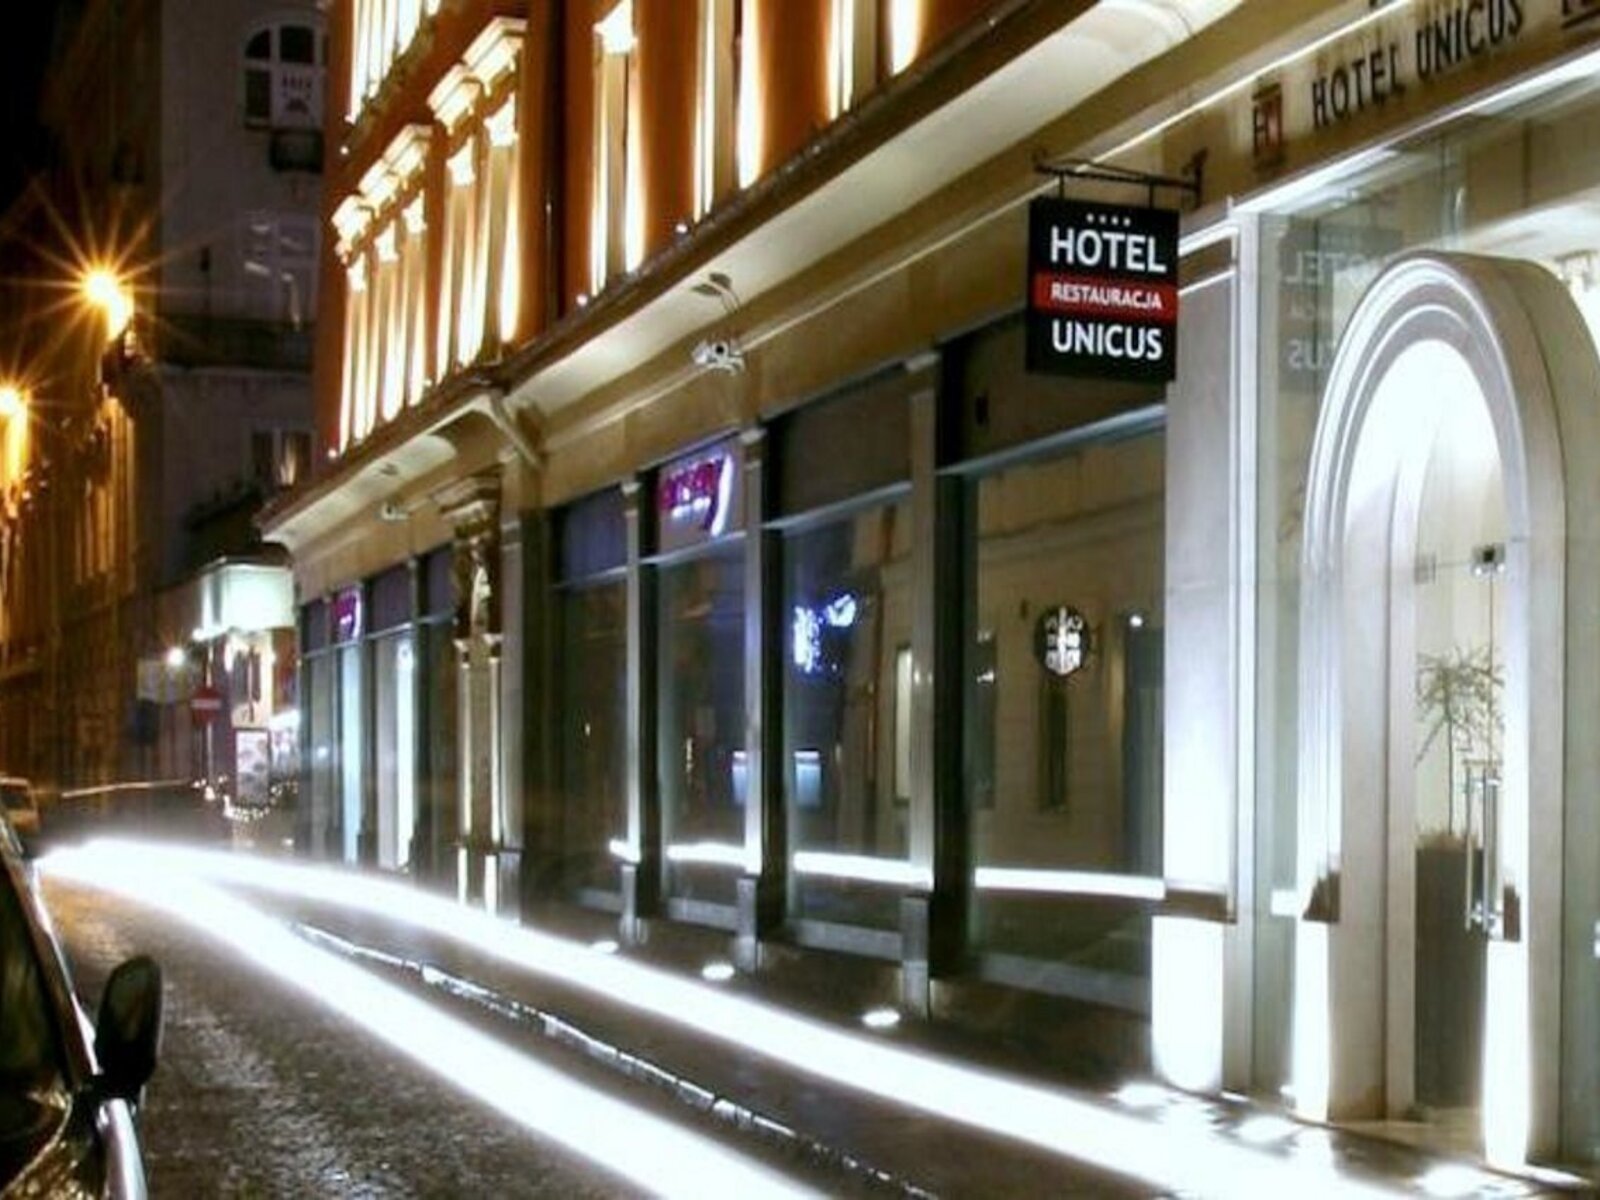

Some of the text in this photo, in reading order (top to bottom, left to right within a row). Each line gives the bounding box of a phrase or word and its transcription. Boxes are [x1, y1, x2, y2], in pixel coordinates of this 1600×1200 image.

[1311, 0, 1524, 129] HOTEL UNICUS
[1051, 225, 1167, 273] HOTEL
[1051, 282, 1163, 310] RESTAURACJA
[1052, 319, 1163, 361] UNICUS
